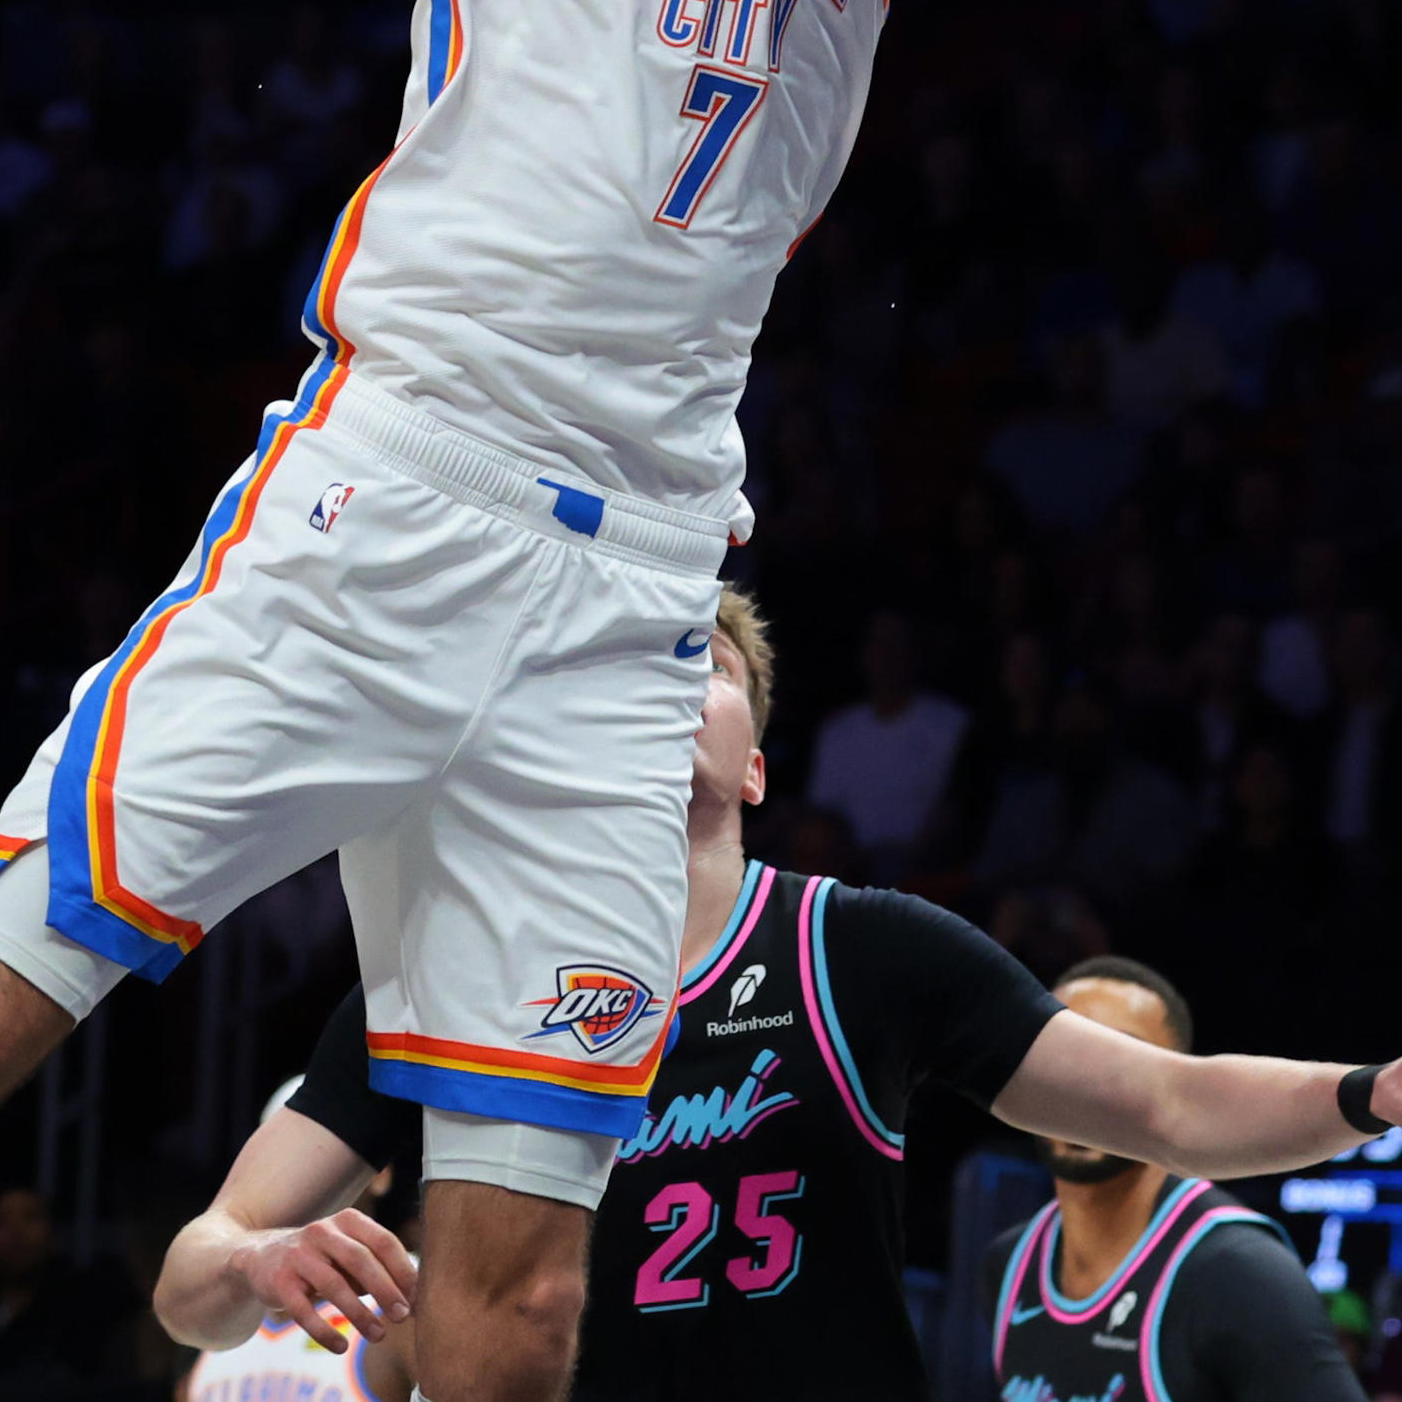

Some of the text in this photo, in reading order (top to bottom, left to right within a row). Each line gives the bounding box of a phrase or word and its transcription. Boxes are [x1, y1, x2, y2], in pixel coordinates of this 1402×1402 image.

[653, 63, 770, 230] 7
[543, 988, 634, 1026] OKC
[707, 1011, 794, 1037] Robinhood
[615, 1049, 801, 1164] ami
[633, 1170, 805, 1313] 25
